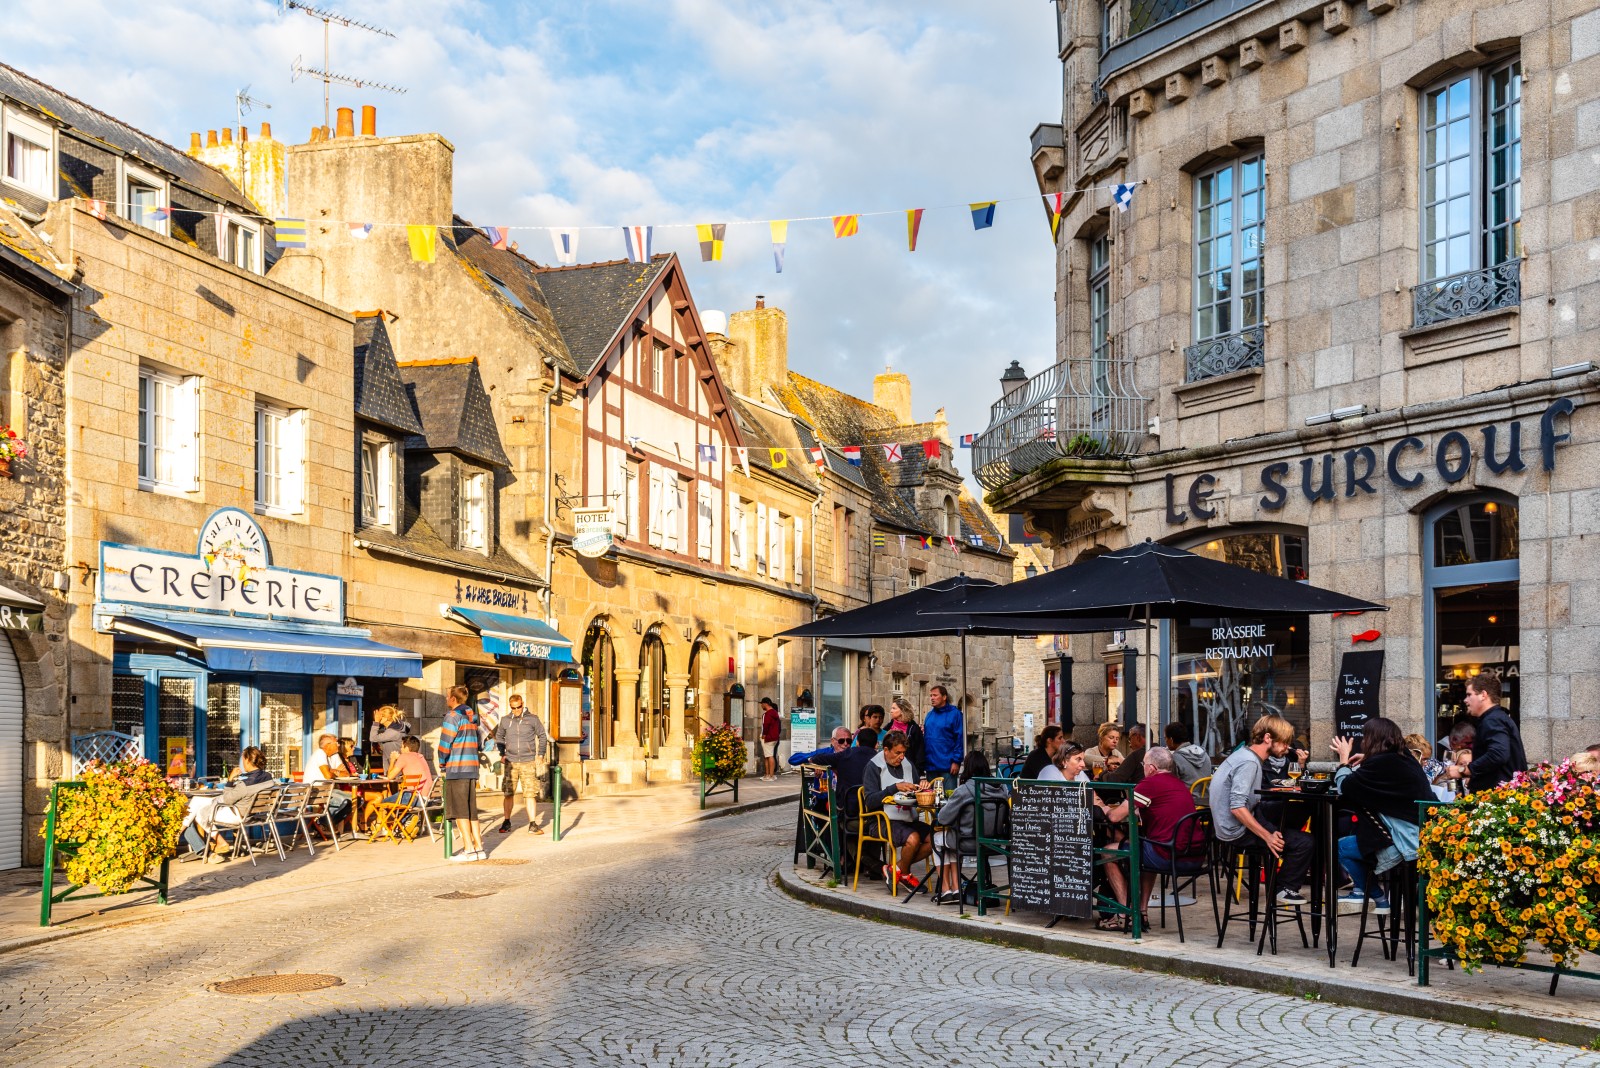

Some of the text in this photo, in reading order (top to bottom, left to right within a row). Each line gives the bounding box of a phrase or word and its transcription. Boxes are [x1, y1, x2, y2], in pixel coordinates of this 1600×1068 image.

[225, 515, 241, 528] An
[576, 514, 610, 524] HOTEL
[1212, 624, 1266, 641] BRASSERIE
[1205, 644, 1275, 660] RESTAURANT
